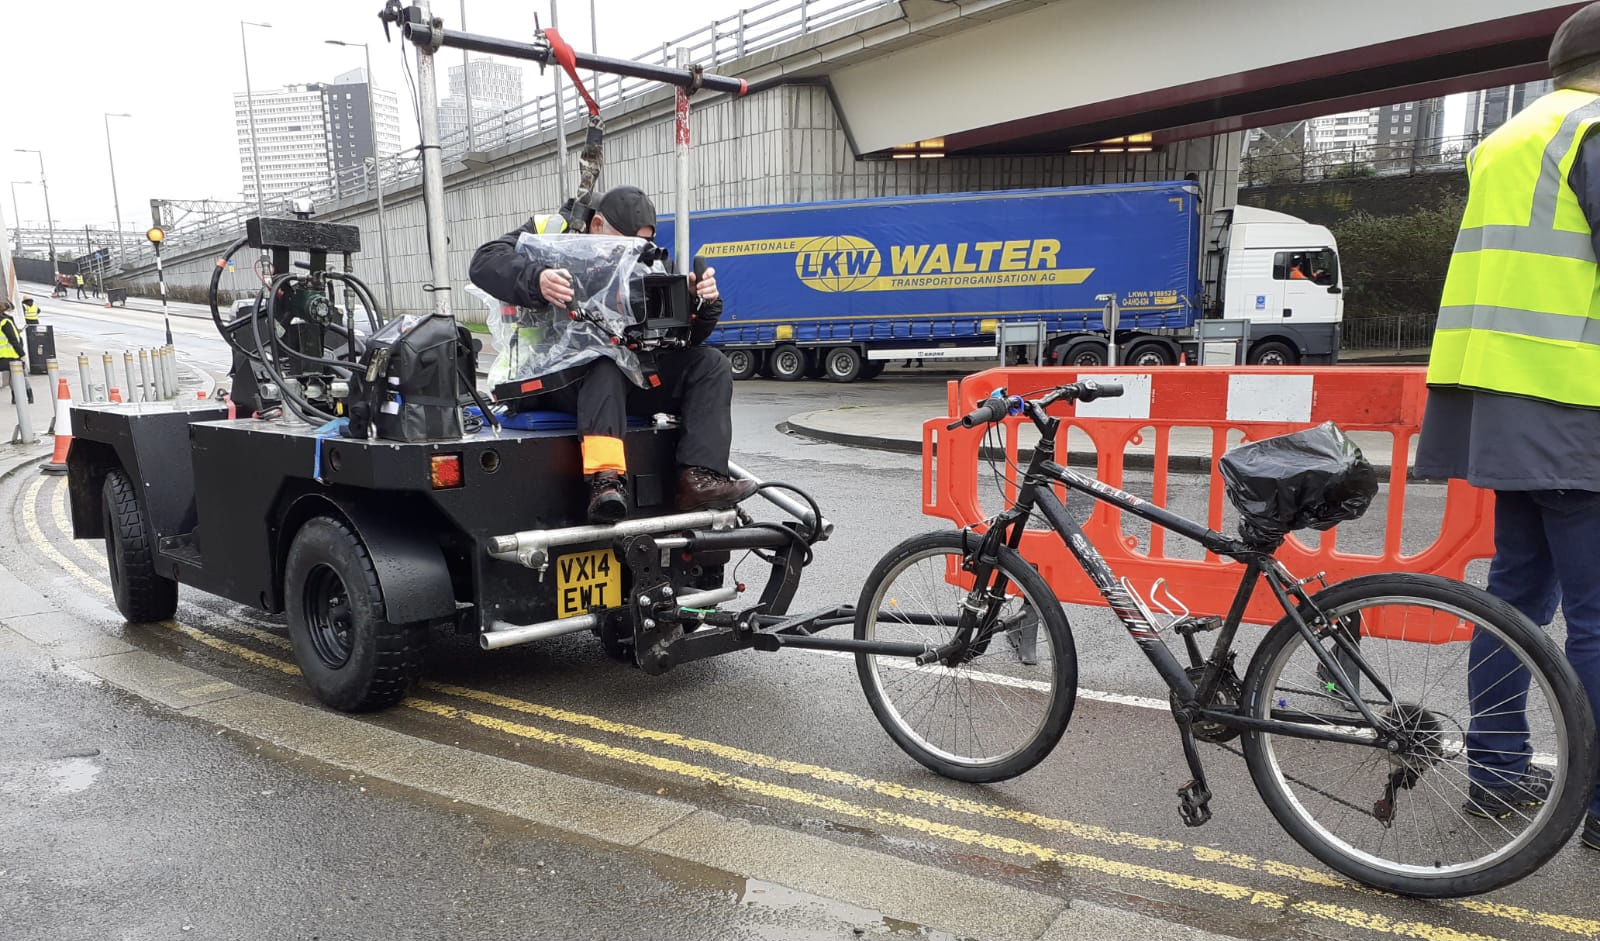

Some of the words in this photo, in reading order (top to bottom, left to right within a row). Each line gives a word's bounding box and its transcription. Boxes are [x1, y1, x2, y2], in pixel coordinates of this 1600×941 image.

[704, 242, 797, 255] INTERNATIONALE
[800, 249, 875, 278] LKW
[890, 239, 1061, 275] WALTER
[891, 274, 1036, 287] TRANSPORTORGANISATION
[1040, 272, 1056, 282] AG
[560, 553, 610, 584] VX14
[564, 583, 608, 613] EWT
